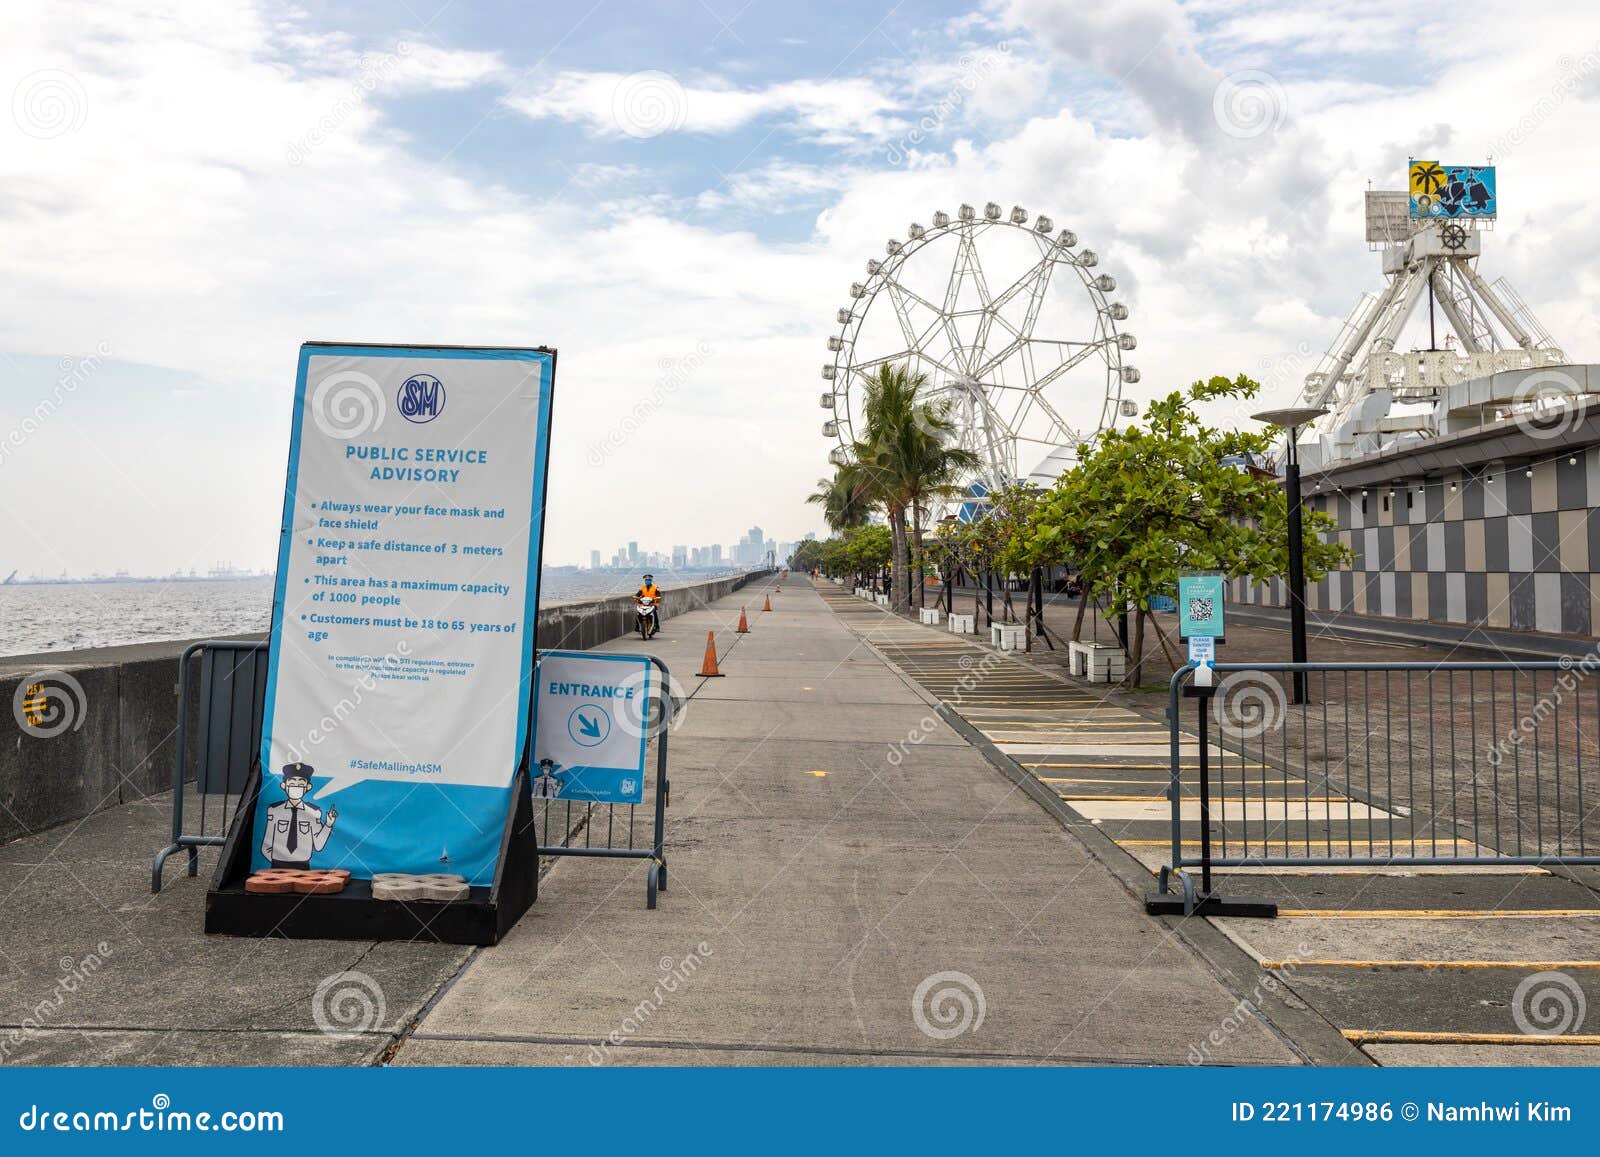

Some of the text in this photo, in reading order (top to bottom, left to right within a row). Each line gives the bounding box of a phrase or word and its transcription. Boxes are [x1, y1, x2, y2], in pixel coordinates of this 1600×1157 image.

[402, 380, 439, 416] SM
[346, 446, 488, 464] PUBLIC SERVICE
[370, 467, 460, 482] ADVISORY
[320, 501, 505, 519] Always wear your face mask and
[319, 518, 379, 530] face shield
[317, 538, 504, 556] Keep a safe distance of 3 meters
[316, 554, 348, 567] apart
[314, 575, 510, 596] This area has a maximum capacity
[312, 591, 401, 607] of 1000 people
[309, 613, 517, 633] Customers must be 18 to 65 years of
[307, 631, 329, 642] age
[549, 682, 634, 699] ENTRANCE
[350, 759, 442, 774] #SafeMallingAtSM
